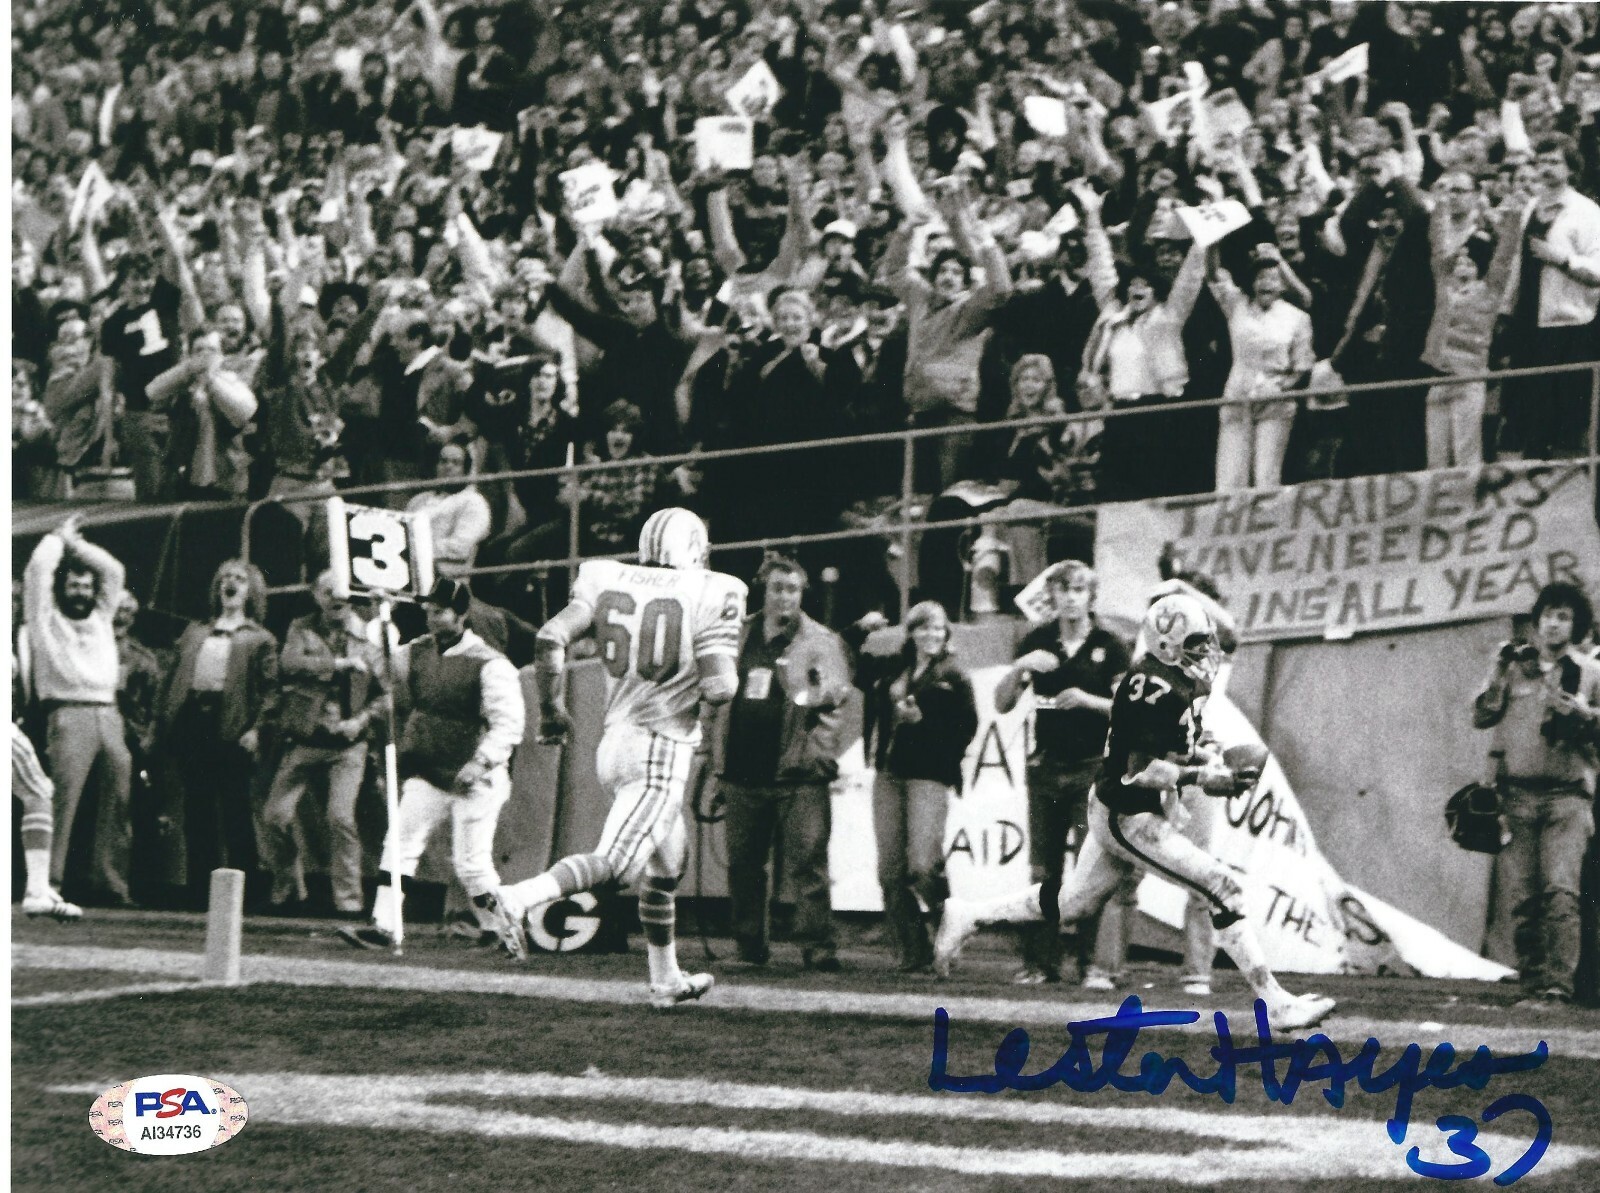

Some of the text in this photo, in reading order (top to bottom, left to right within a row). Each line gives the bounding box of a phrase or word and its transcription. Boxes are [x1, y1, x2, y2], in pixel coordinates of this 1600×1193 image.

[1164, 465, 1556, 537] THE RAIDERS
[349, 511, 410, 590] 3
[617, 569, 682, 589] FISHER
[1305, 512, 1538, 574] NEEDED
[1336, 578, 1423, 625] ALL
[1442, 550, 1586, 611] YEAR
[594, 589, 684, 682] 60
[1128, 672, 1172, 705] 37
[527, 891, 601, 953] G
[1405, 1094, 1553, 1186] 37
